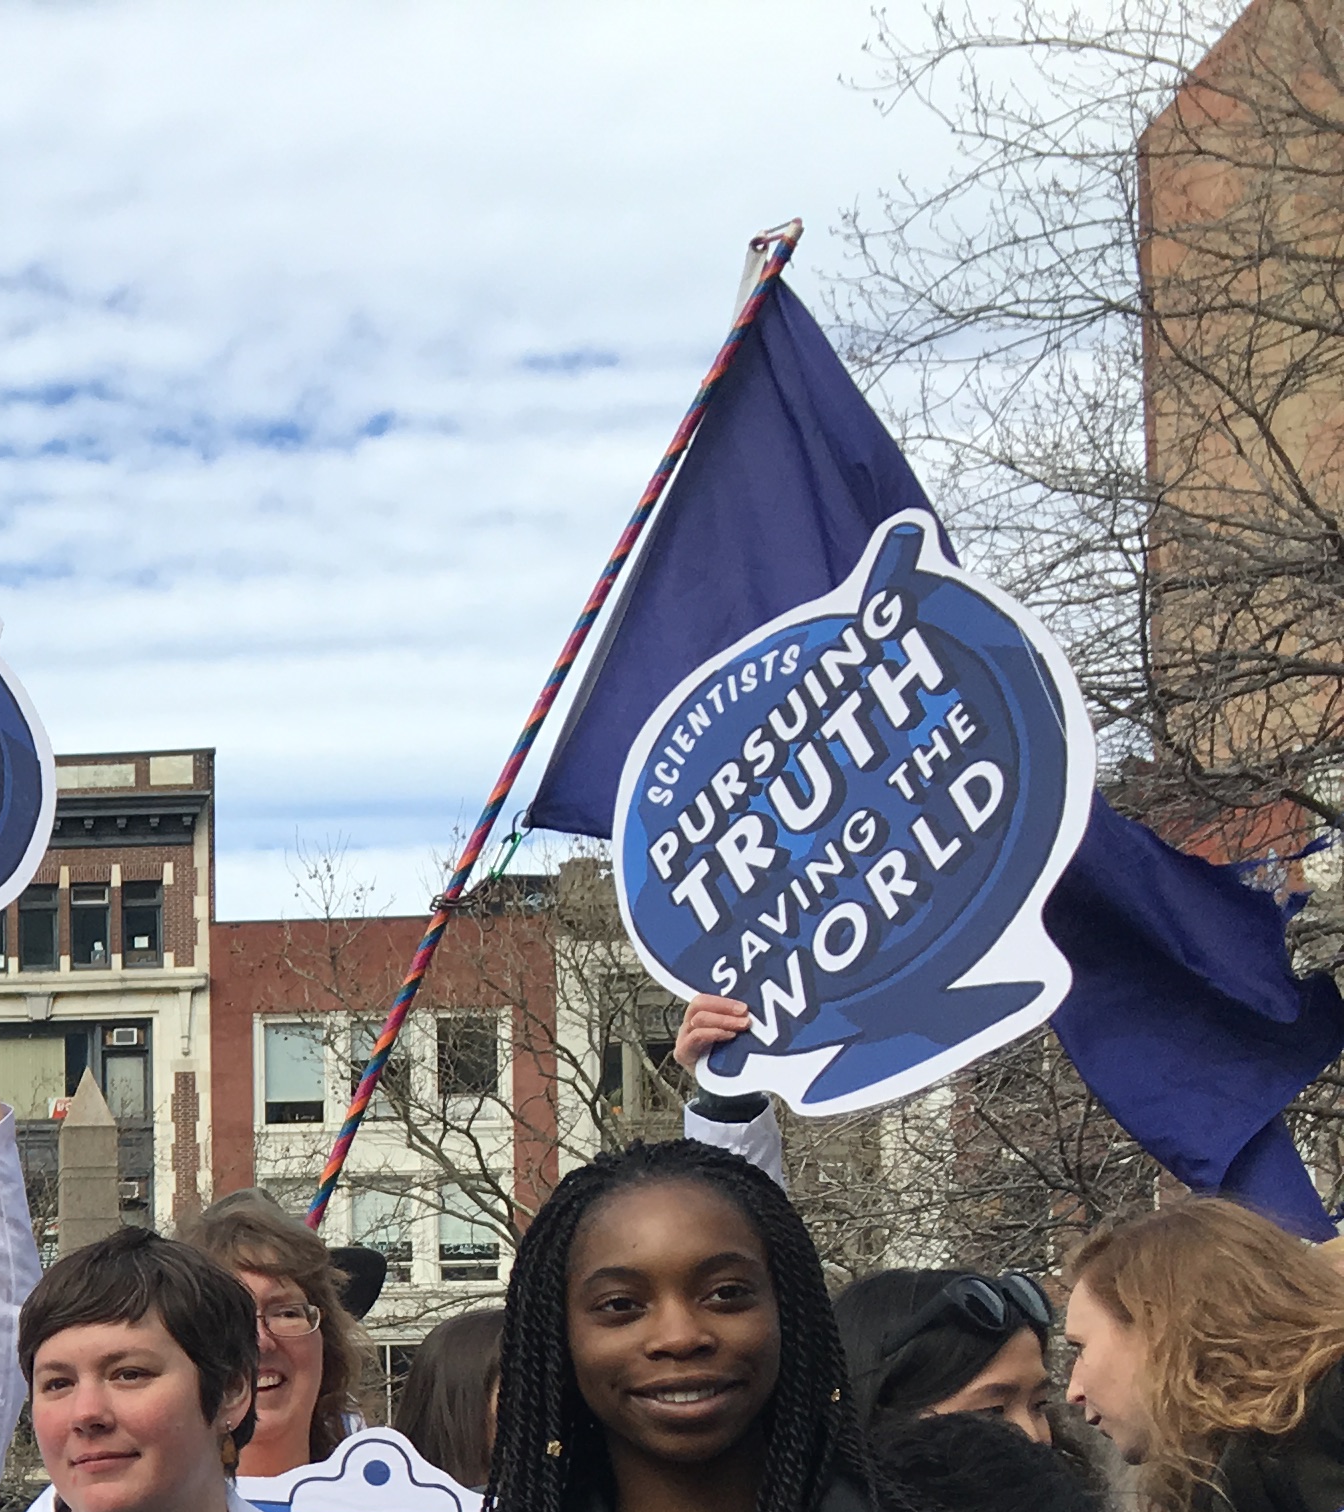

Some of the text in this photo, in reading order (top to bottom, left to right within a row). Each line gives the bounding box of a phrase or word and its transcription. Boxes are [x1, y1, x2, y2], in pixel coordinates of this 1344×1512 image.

[647, 644, 802, 807] SCIENTISTS
[650, 590, 904, 881] PURSUING
[671, 627, 944, 934] TRUTH
[710, 704, 978, 997] SAVING THE
[746, 759, 1005, 1048] WORLD
